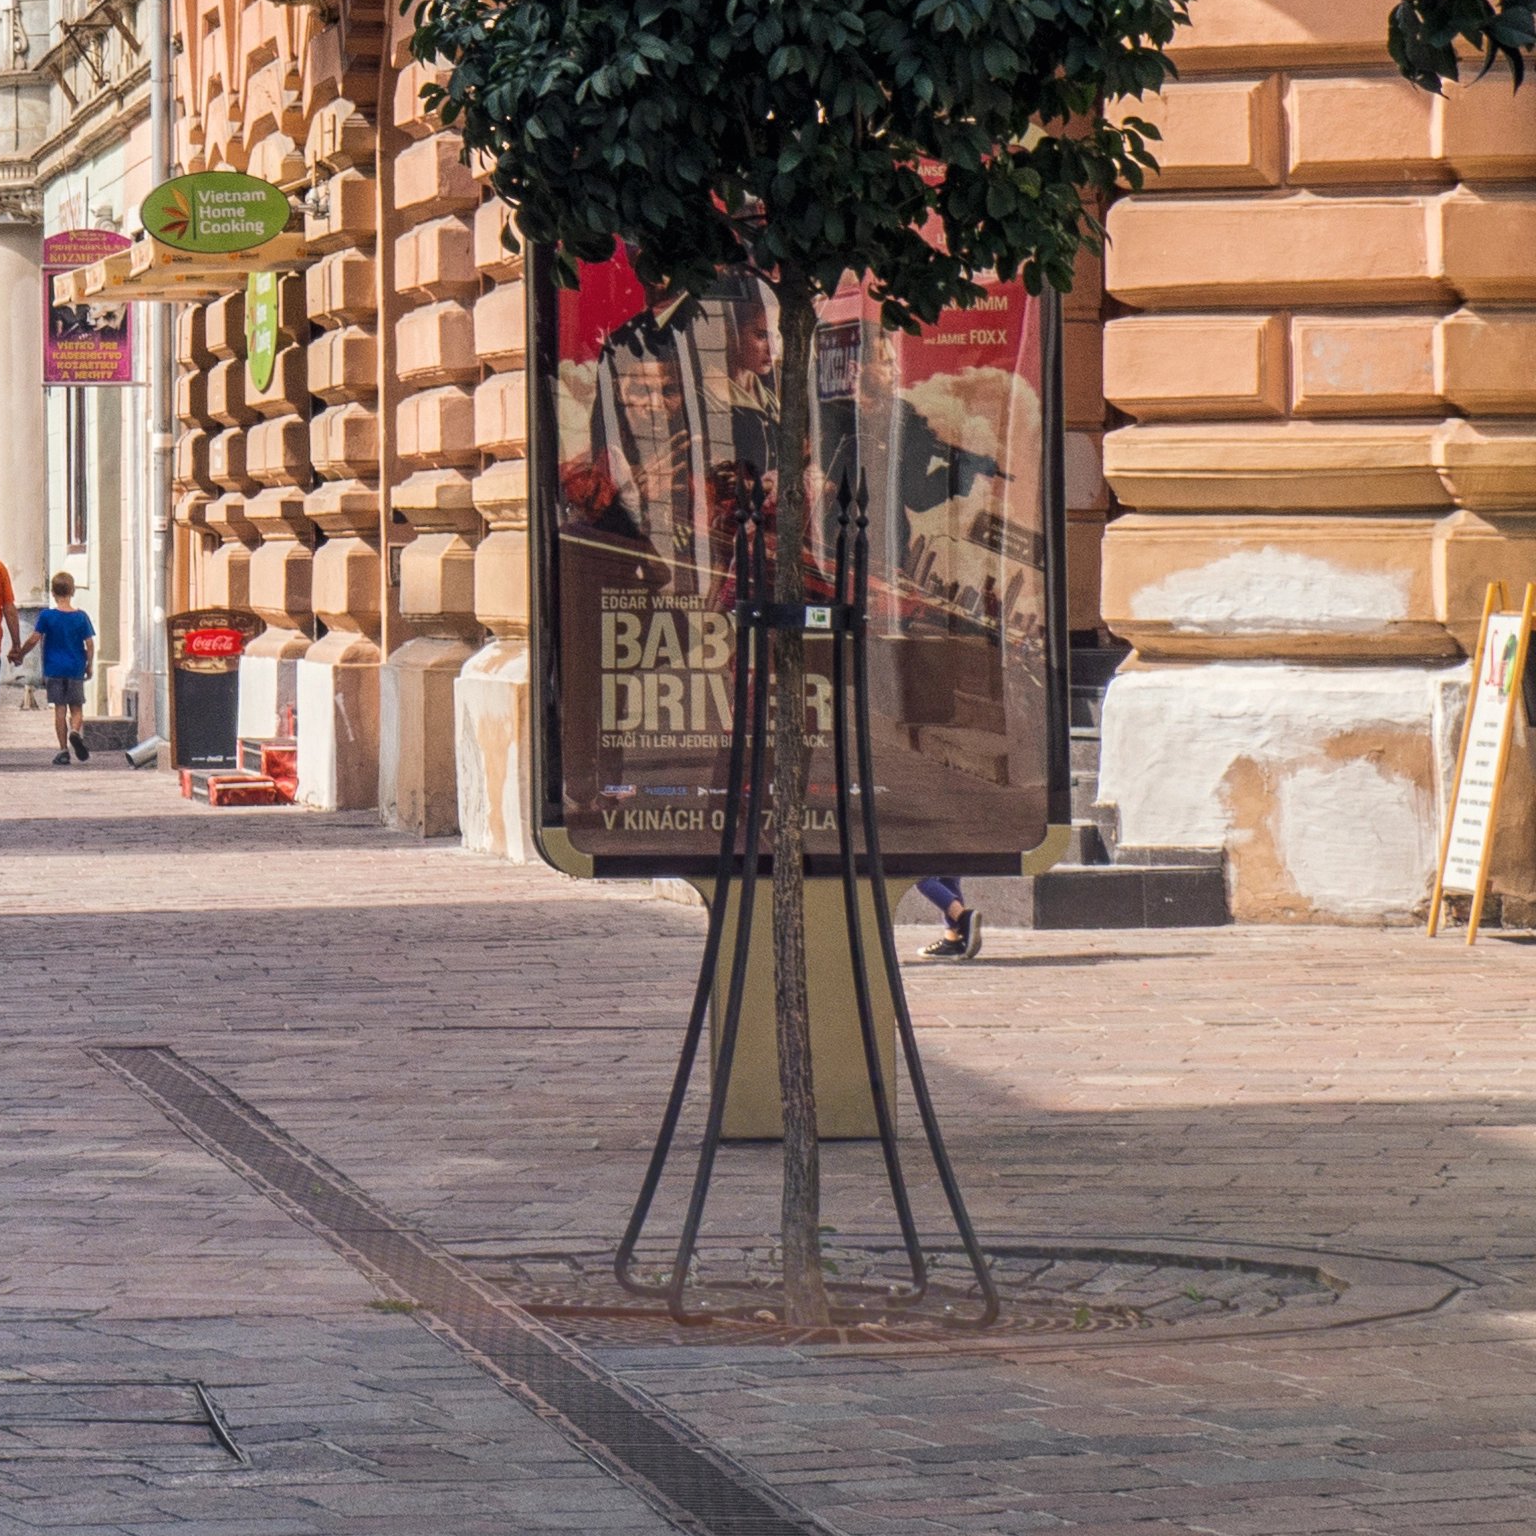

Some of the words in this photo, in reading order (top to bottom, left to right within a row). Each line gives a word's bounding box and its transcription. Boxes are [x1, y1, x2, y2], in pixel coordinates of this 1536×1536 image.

[197, 190, 266, 204] Vietnam
[199, 206, 246, 219] Home
[199, 220, 265, 235] Cooking
[967, 296, 1008, 311] AMM
[936, 333, 967, 345] JAMIE
[970, 330, 1008, 345] FOXX
[601, 595, 648, 610] EDGAR
[651, 595, 707, 610] WRIGHT
[639, 735, 651, 748] TI
[653, 735, 677, 748] LEN
[679, 735, 718, 748] JEDEN
[602, 810, 618, 831] V
[623, 804, 703, 831] KINÁCH
